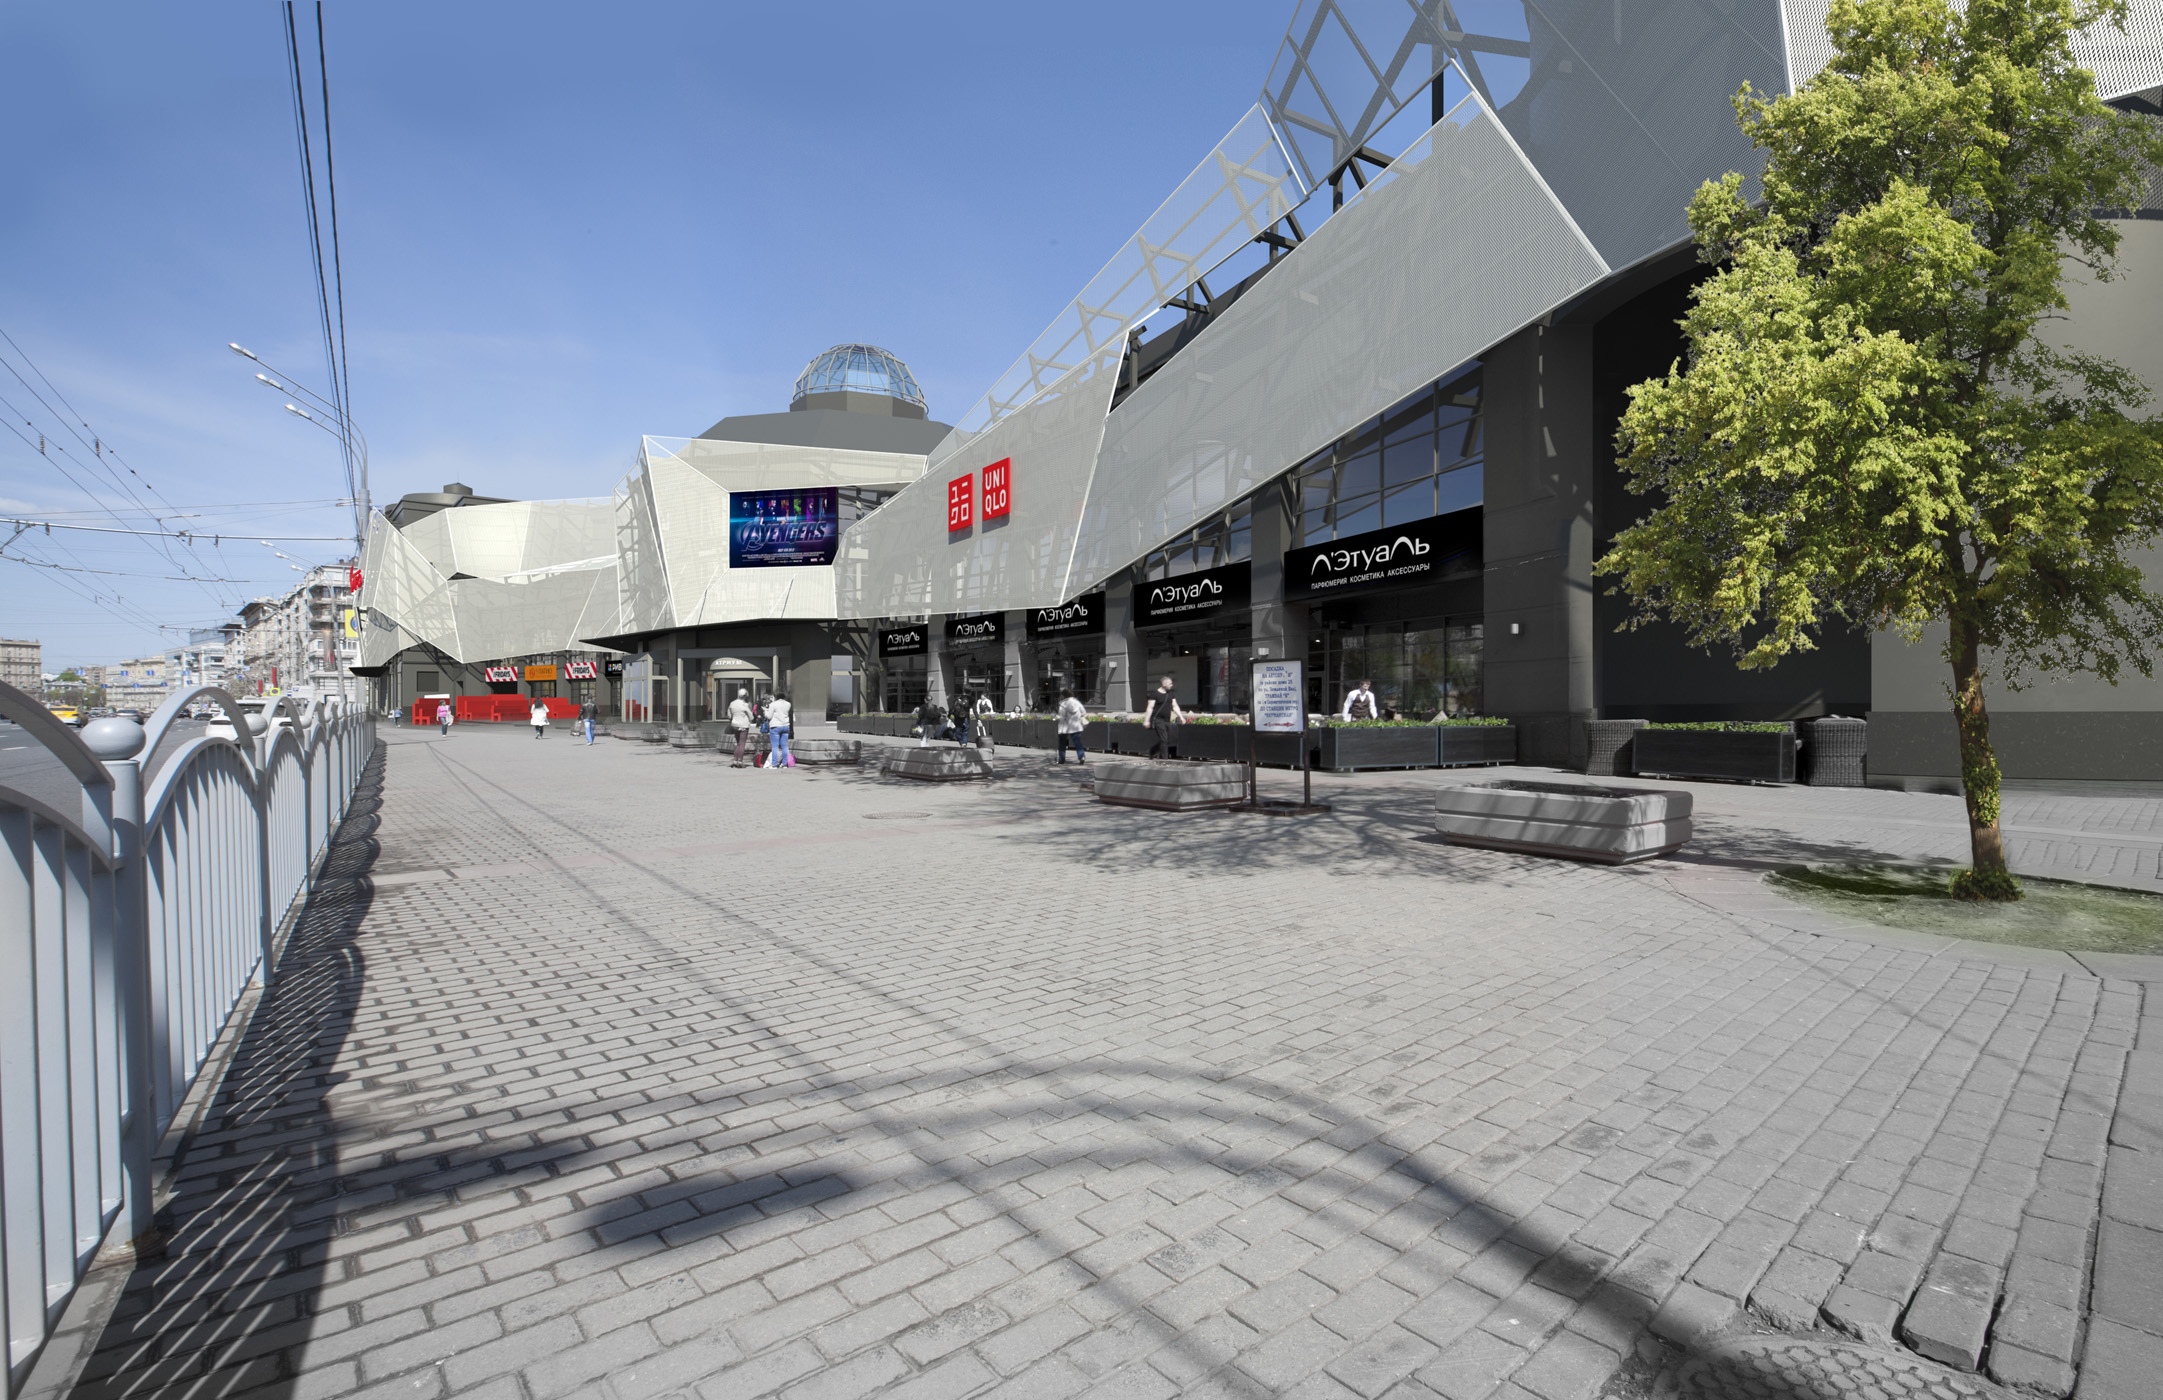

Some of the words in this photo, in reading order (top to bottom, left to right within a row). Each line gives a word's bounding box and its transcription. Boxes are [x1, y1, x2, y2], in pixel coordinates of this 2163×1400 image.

[985, 466, 1004, 490] UNI
[985, 489, 1006, 515] QLO
[740, 520, 828, 552] AVENGERS
[1311, 578, 1348, 590] ПАРФЮМЕРИЯ
[1350, 571, 1384, 583] КОСМЕТИКА
[1387, 563, 1430, 576] АКСЕССУАРЫ
